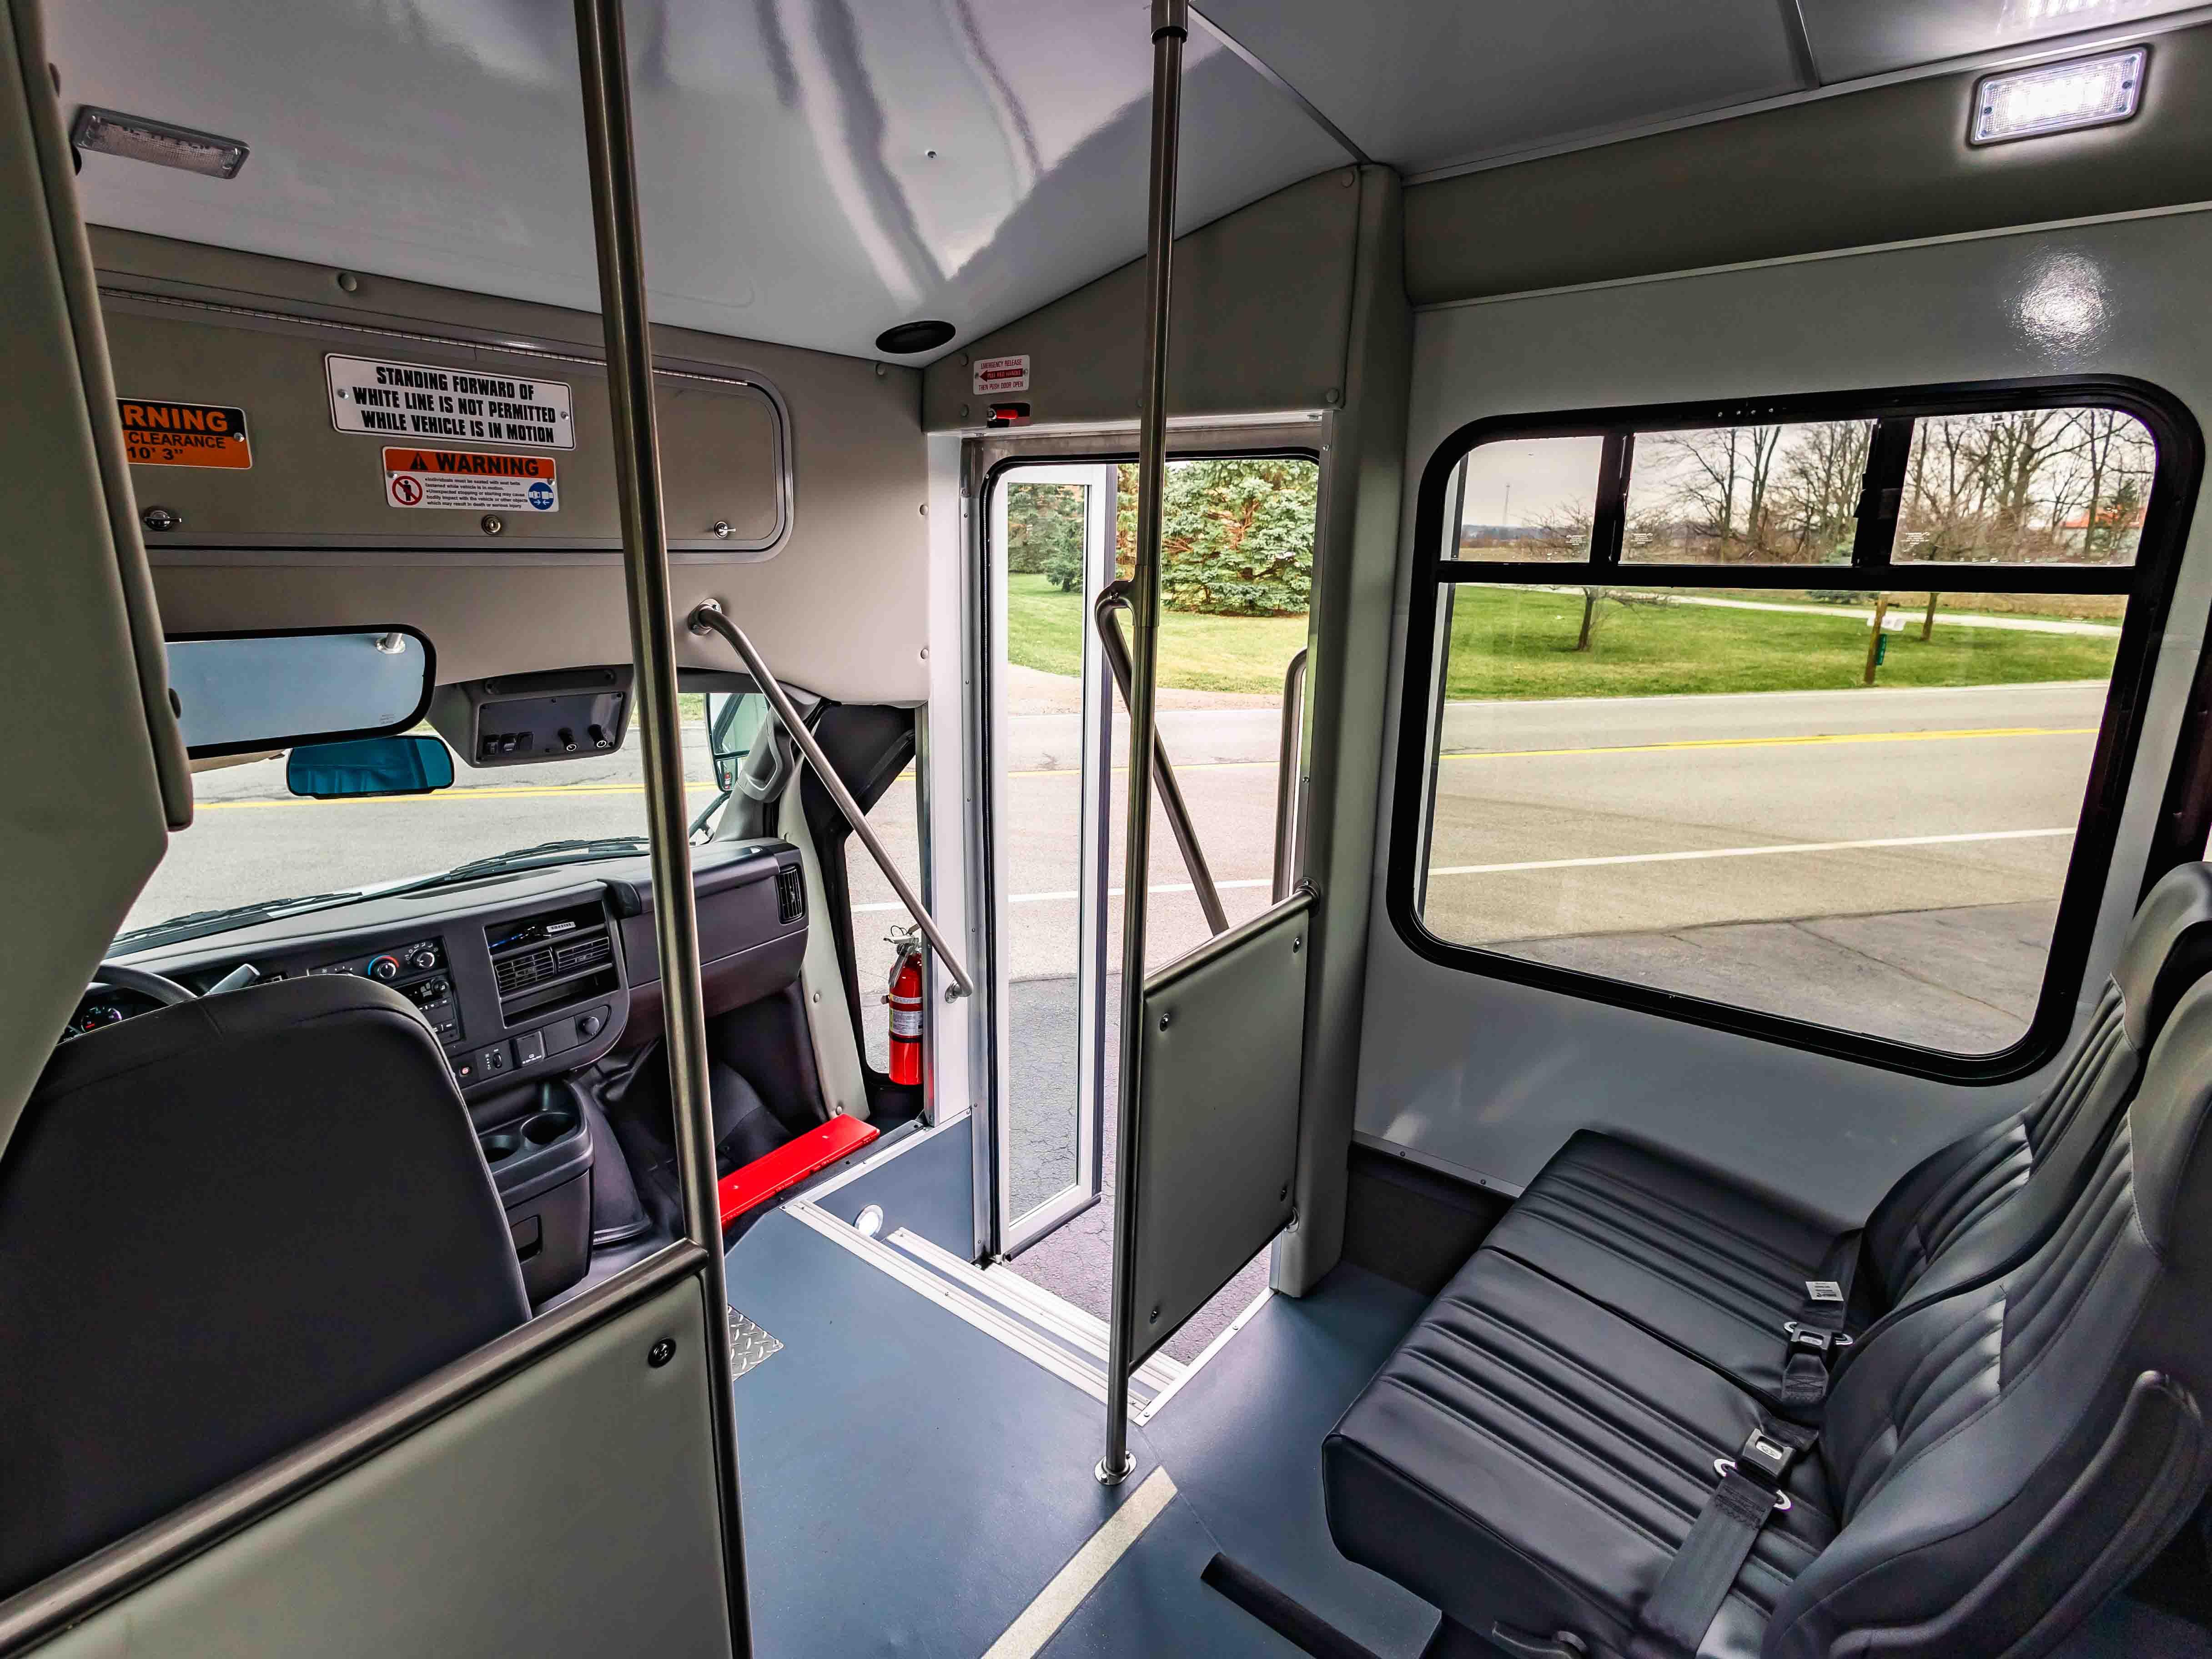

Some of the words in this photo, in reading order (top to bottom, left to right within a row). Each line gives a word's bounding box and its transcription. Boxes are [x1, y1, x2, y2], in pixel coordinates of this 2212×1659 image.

[376, 366, 448, 391] STANDING
[452, 375, 515, 398] FORWARD
[519, 383, 534, 401] OF
[123, 404, 227, 432] RNING
[352, 387, 401, 408] WHITE
[404, 392, 435, 412] LINE
[439, 396, 453, 413] IS
[458, 398, 483, 416] NOT
[488, 401, 556, 423] PERMITTED
[128, 432, 226, 449] CLEARANCE
[361, 410, 407, 431] WHILE
[411, 414, 466, 436] VEHICLE
[470, 420, 484, 437] IS
[488, 422, 503, 439] IN
[506, 423, 554, 443] MOTION
[435, 452, 539, 476] WARNING
